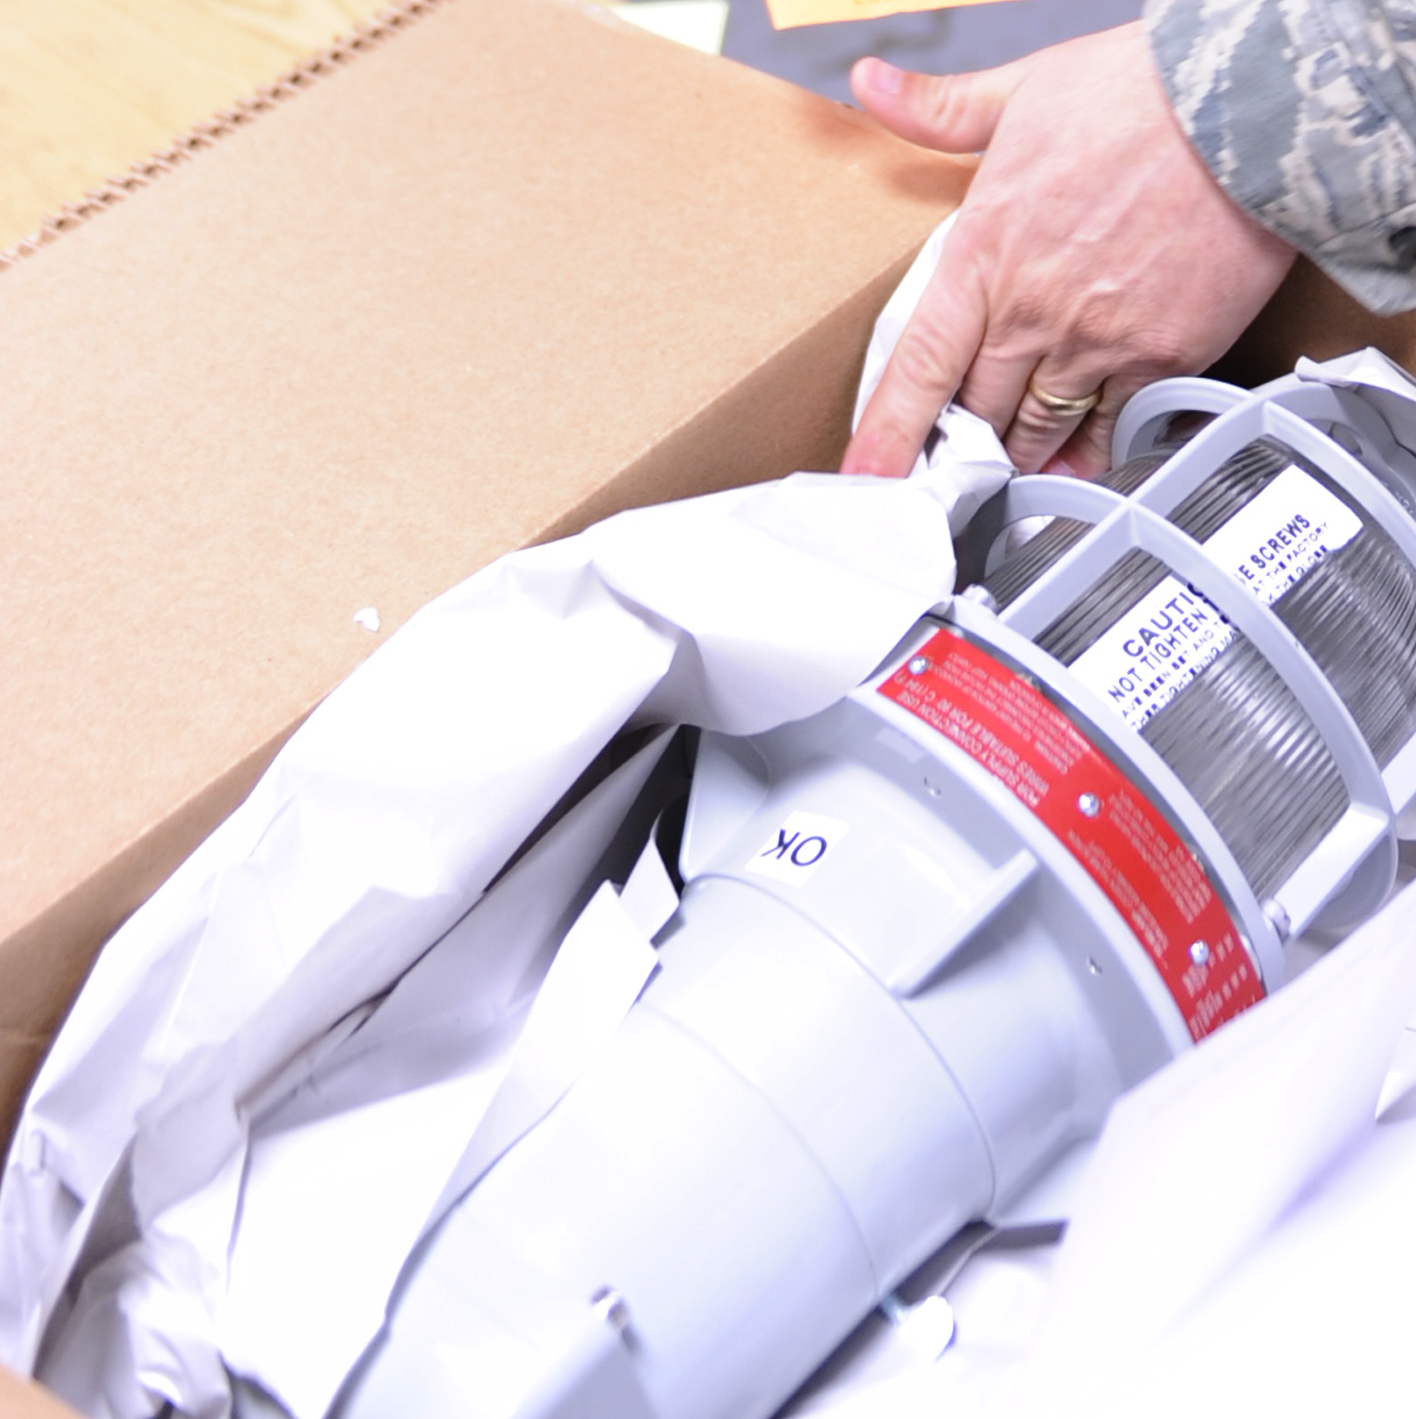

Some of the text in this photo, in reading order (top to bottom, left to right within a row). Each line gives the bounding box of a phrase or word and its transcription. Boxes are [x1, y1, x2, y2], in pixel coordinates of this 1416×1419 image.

[1107, 512, 1311, 703] NOT TIGHTEN SCREWS
[1121, 581, 1204, 660] CAUTI
[1191, 628, 1215, 652] AND
[1265, 560, 1287, 581] THE
[1286, 521, 1330, 562] FACTORY
[761, 827, 827, 868] OK
